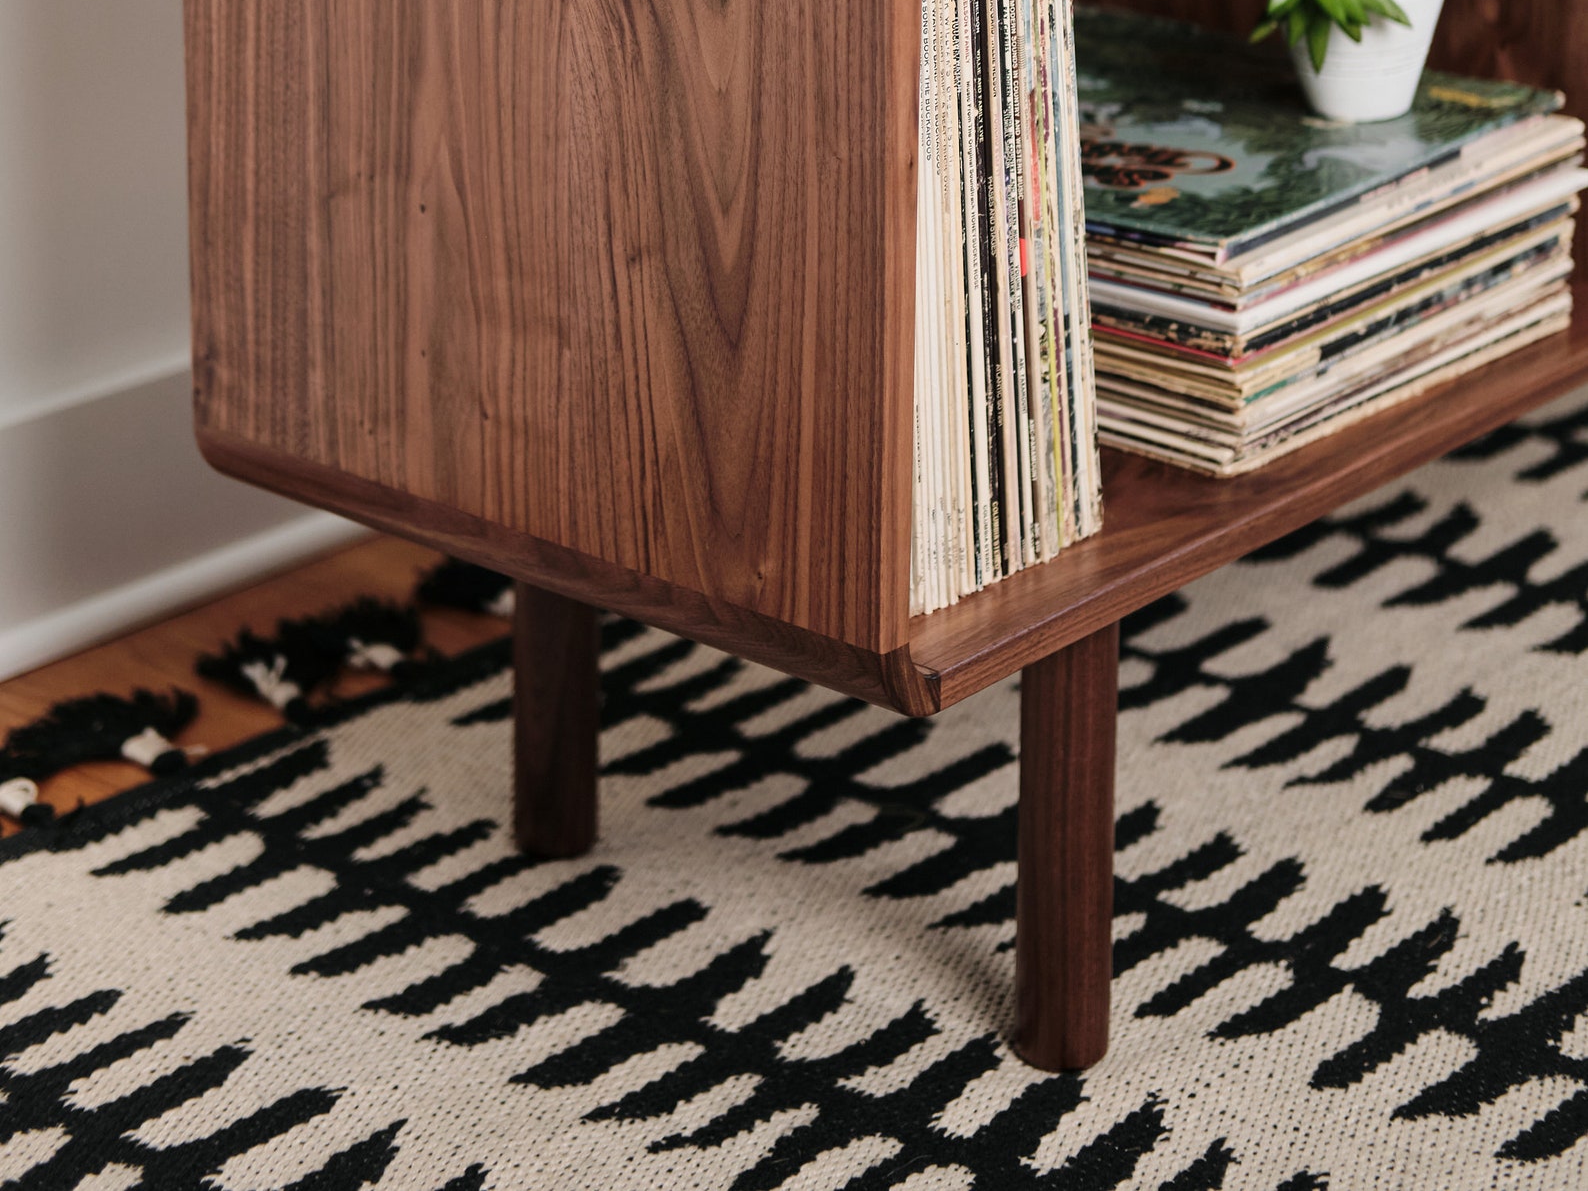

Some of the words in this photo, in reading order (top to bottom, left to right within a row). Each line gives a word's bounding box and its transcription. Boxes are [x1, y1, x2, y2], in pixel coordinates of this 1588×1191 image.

[1009, 0, 1017, 34] MODERN
[1012, 70, 1019, 79] IN
[1013, 80, 1021, 117] COUNTRY
[1015, 137, 1023, 174] WESTERN
[987, 176, 995, 207] PHASES
[971, 211, 979, 268] HONEYSUCKLE
[989, 226, 997, 257] STAGES
[1020, 374, 1028, 414] PARAMOUNT
